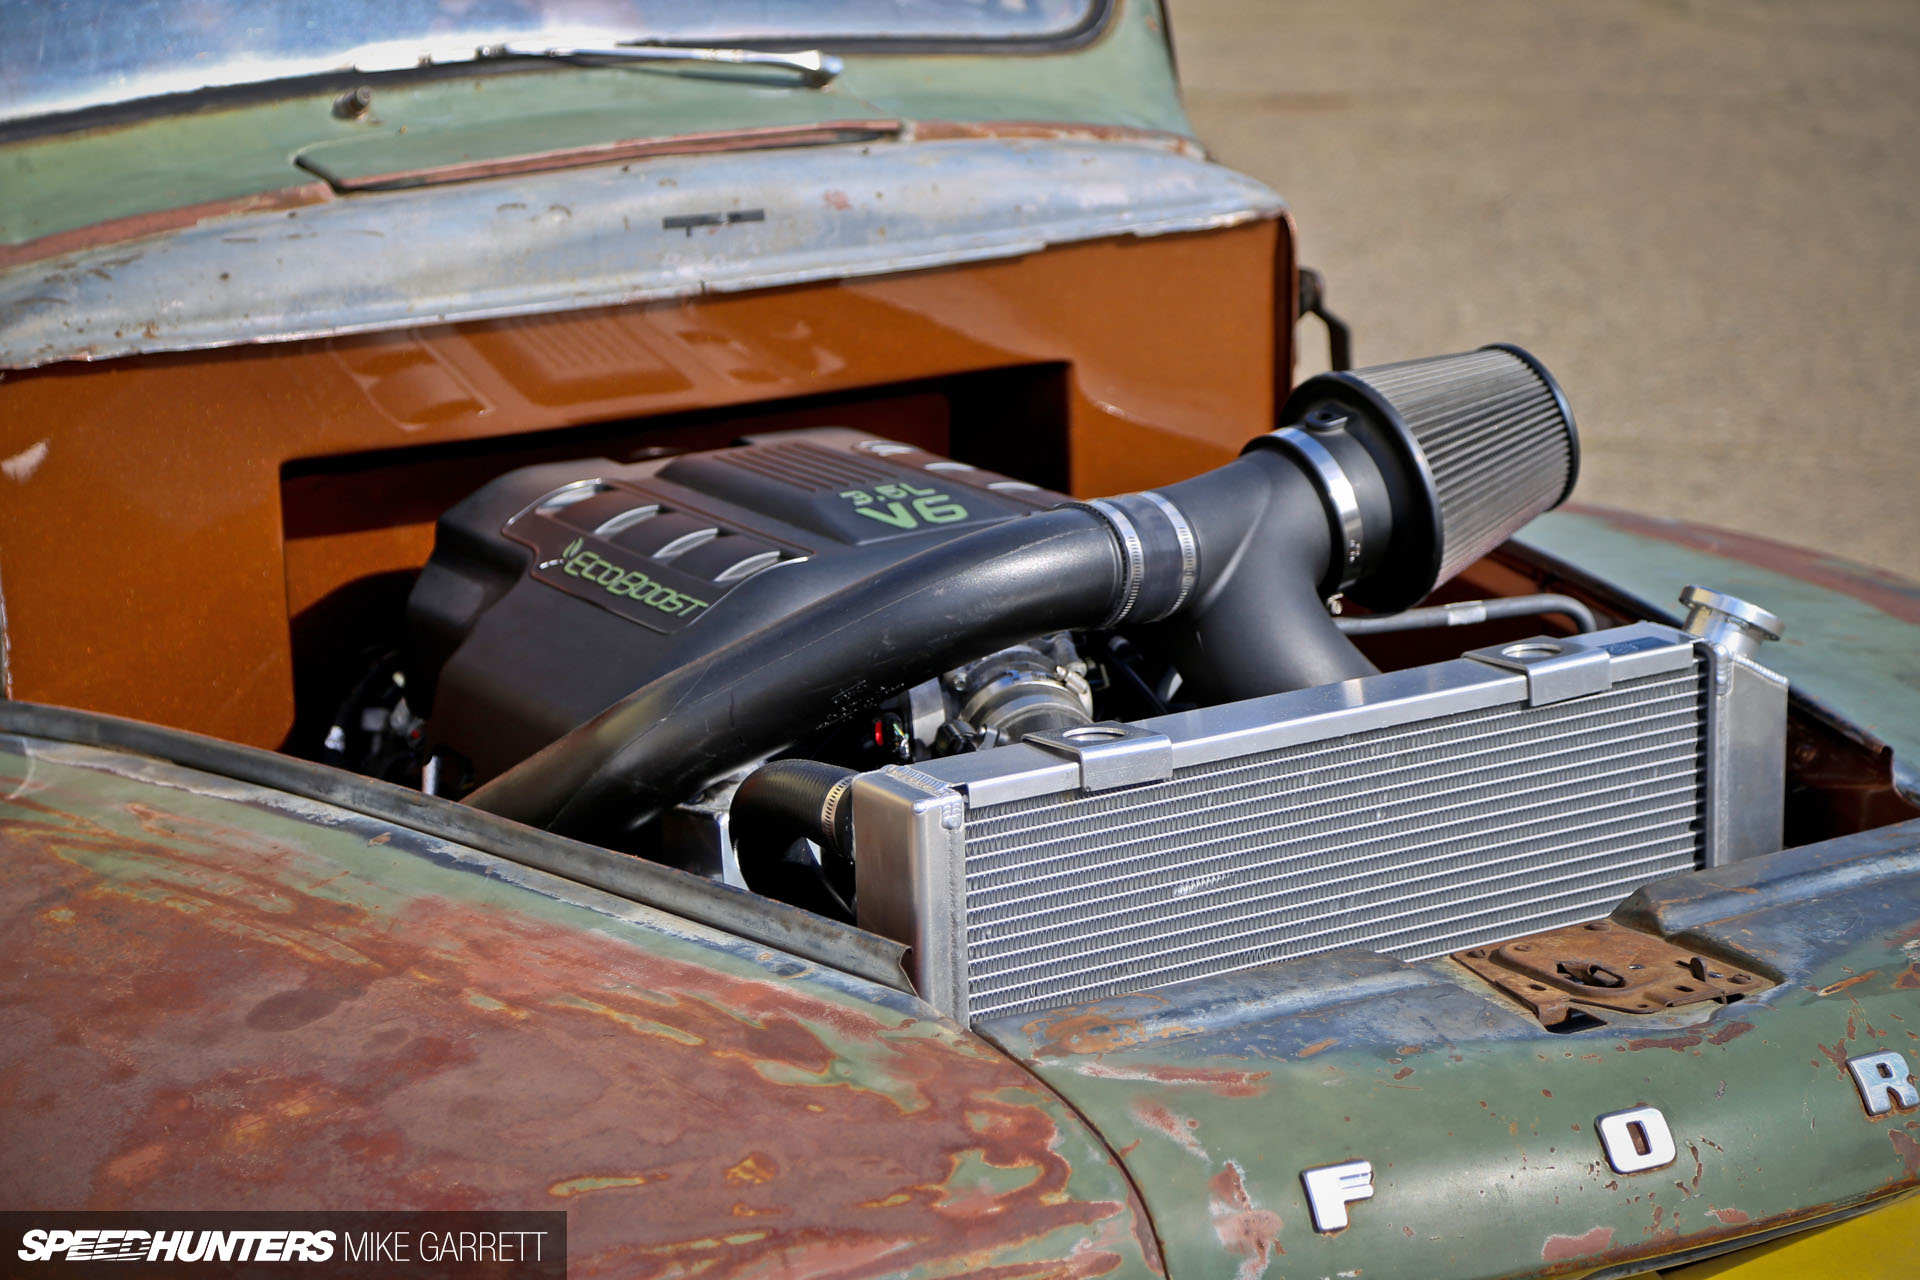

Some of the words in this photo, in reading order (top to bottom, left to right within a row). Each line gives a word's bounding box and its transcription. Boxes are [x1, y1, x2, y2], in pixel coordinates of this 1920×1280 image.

[839, 482, 936, 506] 3.5L
[855, 494, 969, 529] V6
[563, 551, 709, 617] ECOBOOST
